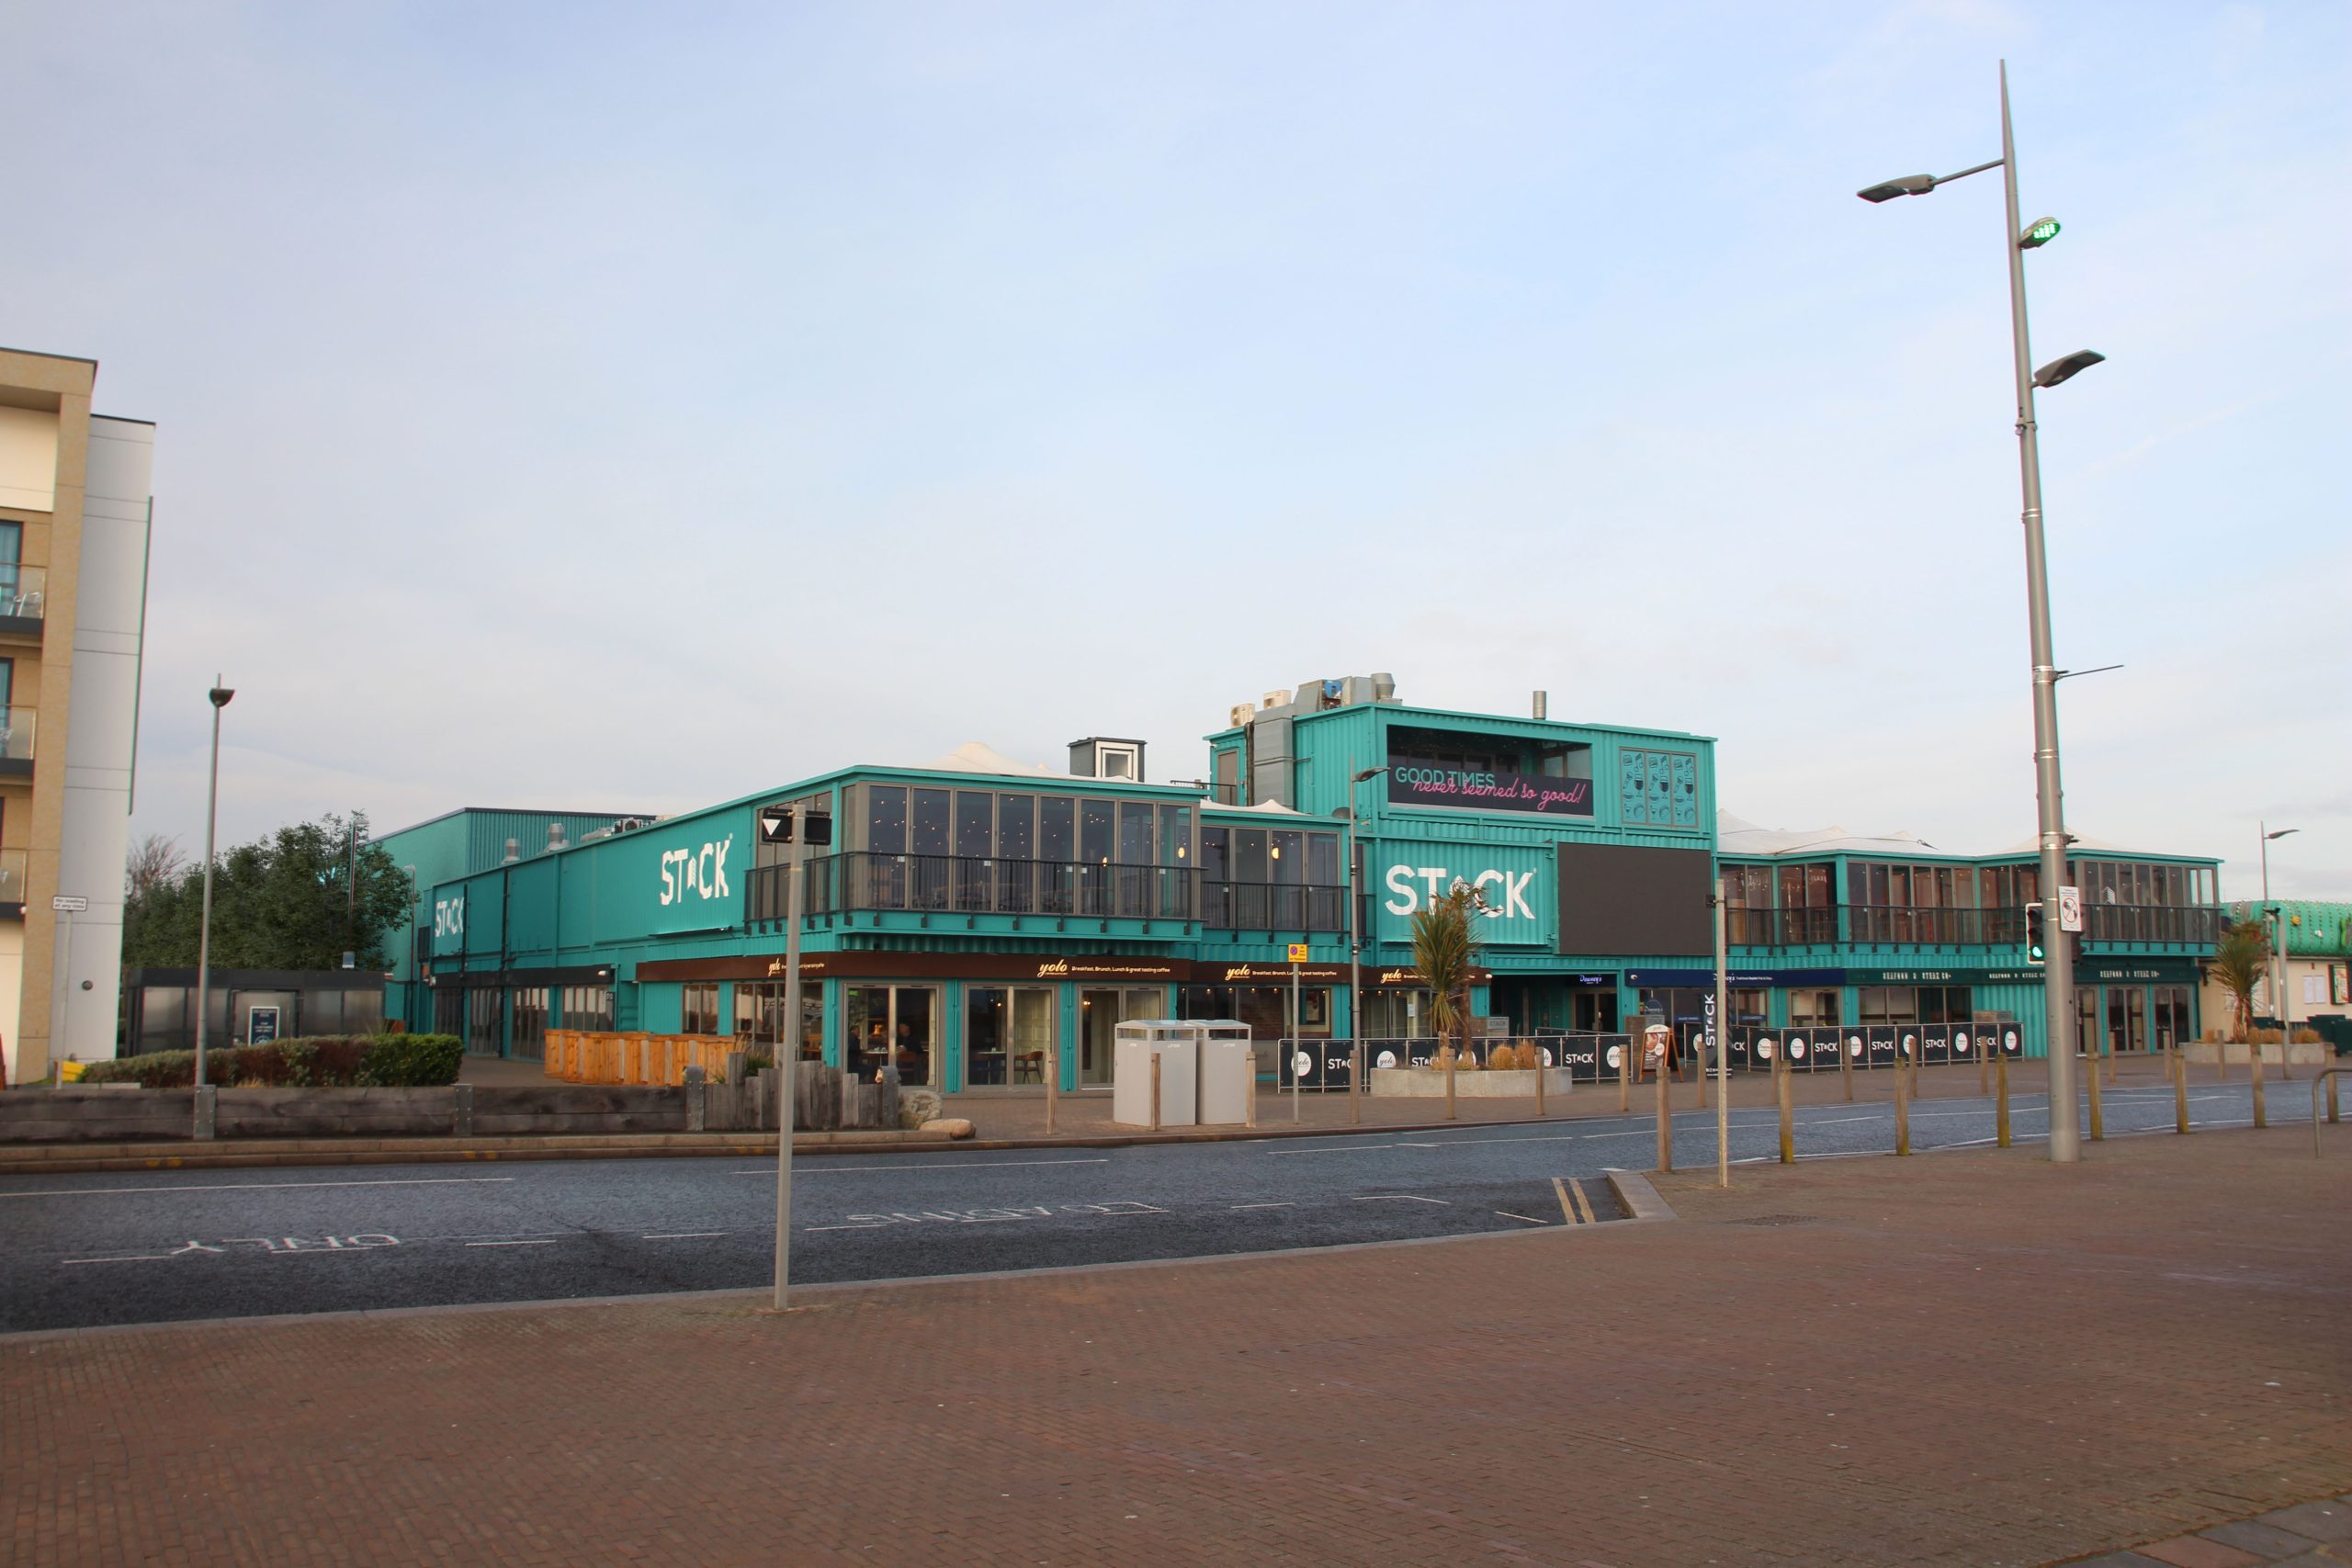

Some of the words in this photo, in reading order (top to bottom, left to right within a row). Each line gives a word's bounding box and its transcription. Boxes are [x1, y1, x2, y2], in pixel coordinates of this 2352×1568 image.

[1395, 766, 1444, 784] GOOD
[1447, 770, 1496, 788] TIMES
[1413, 777, 1458, 794] never
[1462, 777, 1518, 797] seemed
[1521, 783, 1537, 799] so
[1536, 783, 1587, 811] good!
[1037, 958, 1069, 977] yolo
[1225, 964, 1250, 981] yolo
[1380, 968, 1402, 984] yolo
[1976, 1037, 1996, 1046] SCK
[1297, 1057, 1310, 1066] olo
[170, 1234, 401, 1255] ONLY
